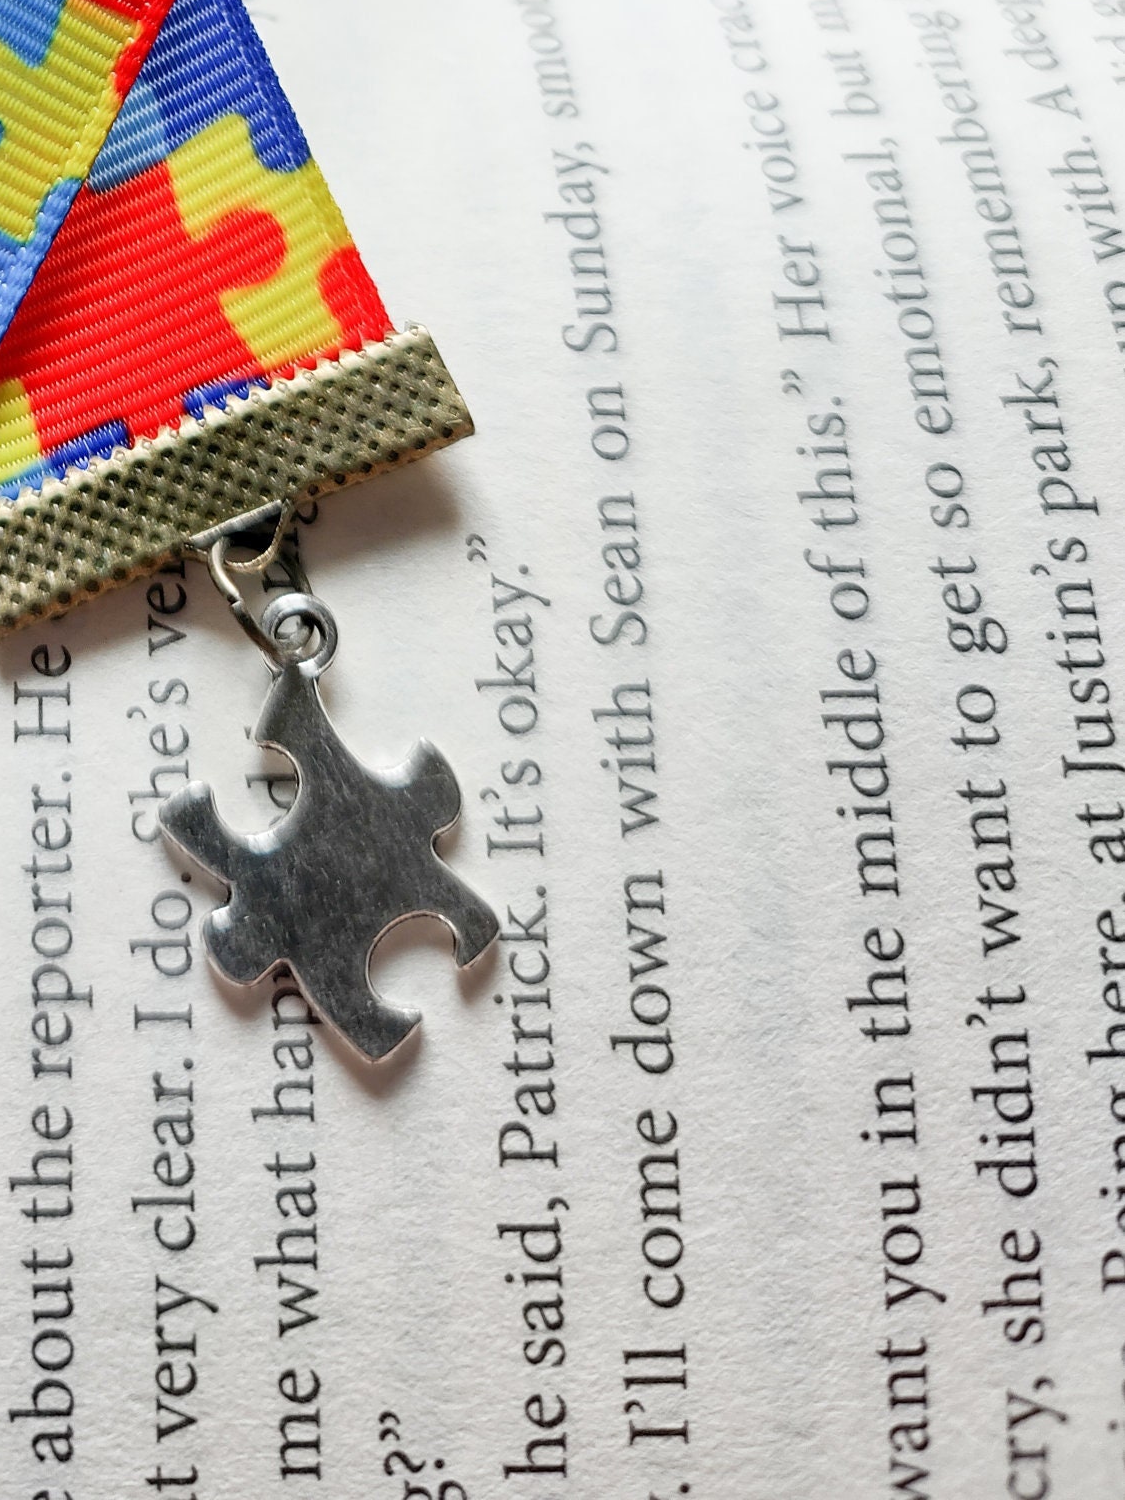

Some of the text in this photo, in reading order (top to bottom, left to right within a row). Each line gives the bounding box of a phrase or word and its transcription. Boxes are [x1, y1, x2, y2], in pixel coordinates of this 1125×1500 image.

[744, 91, 805, 214] voice
[1029, 85, 1082, 120] A
[544, 143, 618, 353] Sunday,
[1050, 137, 1125, 263] with.
[774, 236, 832, 341] Her
[587, 386, 630, 461] on
[915, 10, 1125, 864] at Justin’s park, remembering
[589, 494, 648, 646] Sean
[805, 550, 870, 621] of
[592, 680, 659, 838] with
[820, 650, 900, 897] middle
[826, 50, 1069, 1500] cry, she didn’t want to get so emotional, but
[127, 870, 194, 978] do.
[610, 871, 675, 1075] down
[847, 928, 912, 1042] the
[8, 642, 93, 1463] about the reporter. He
[134, 1005, 193, 1030] I
[465, 533, 569, 1479] he said, Patrick. It’s okay.”
[131, 1059, 197, 1254] clear.
[860, 1074, 917, 1144] in
[254, 1153, 319, 1338] what
[637, 1110, 685, 1309] come
[881, 1176, 947, 1310] you
[158, 1275, 219, 1444] very
[278, 1369, 321, 1480] me
[623, 1345, 689, 1446] I’ll
[877, 1339, 930, 1500] want
